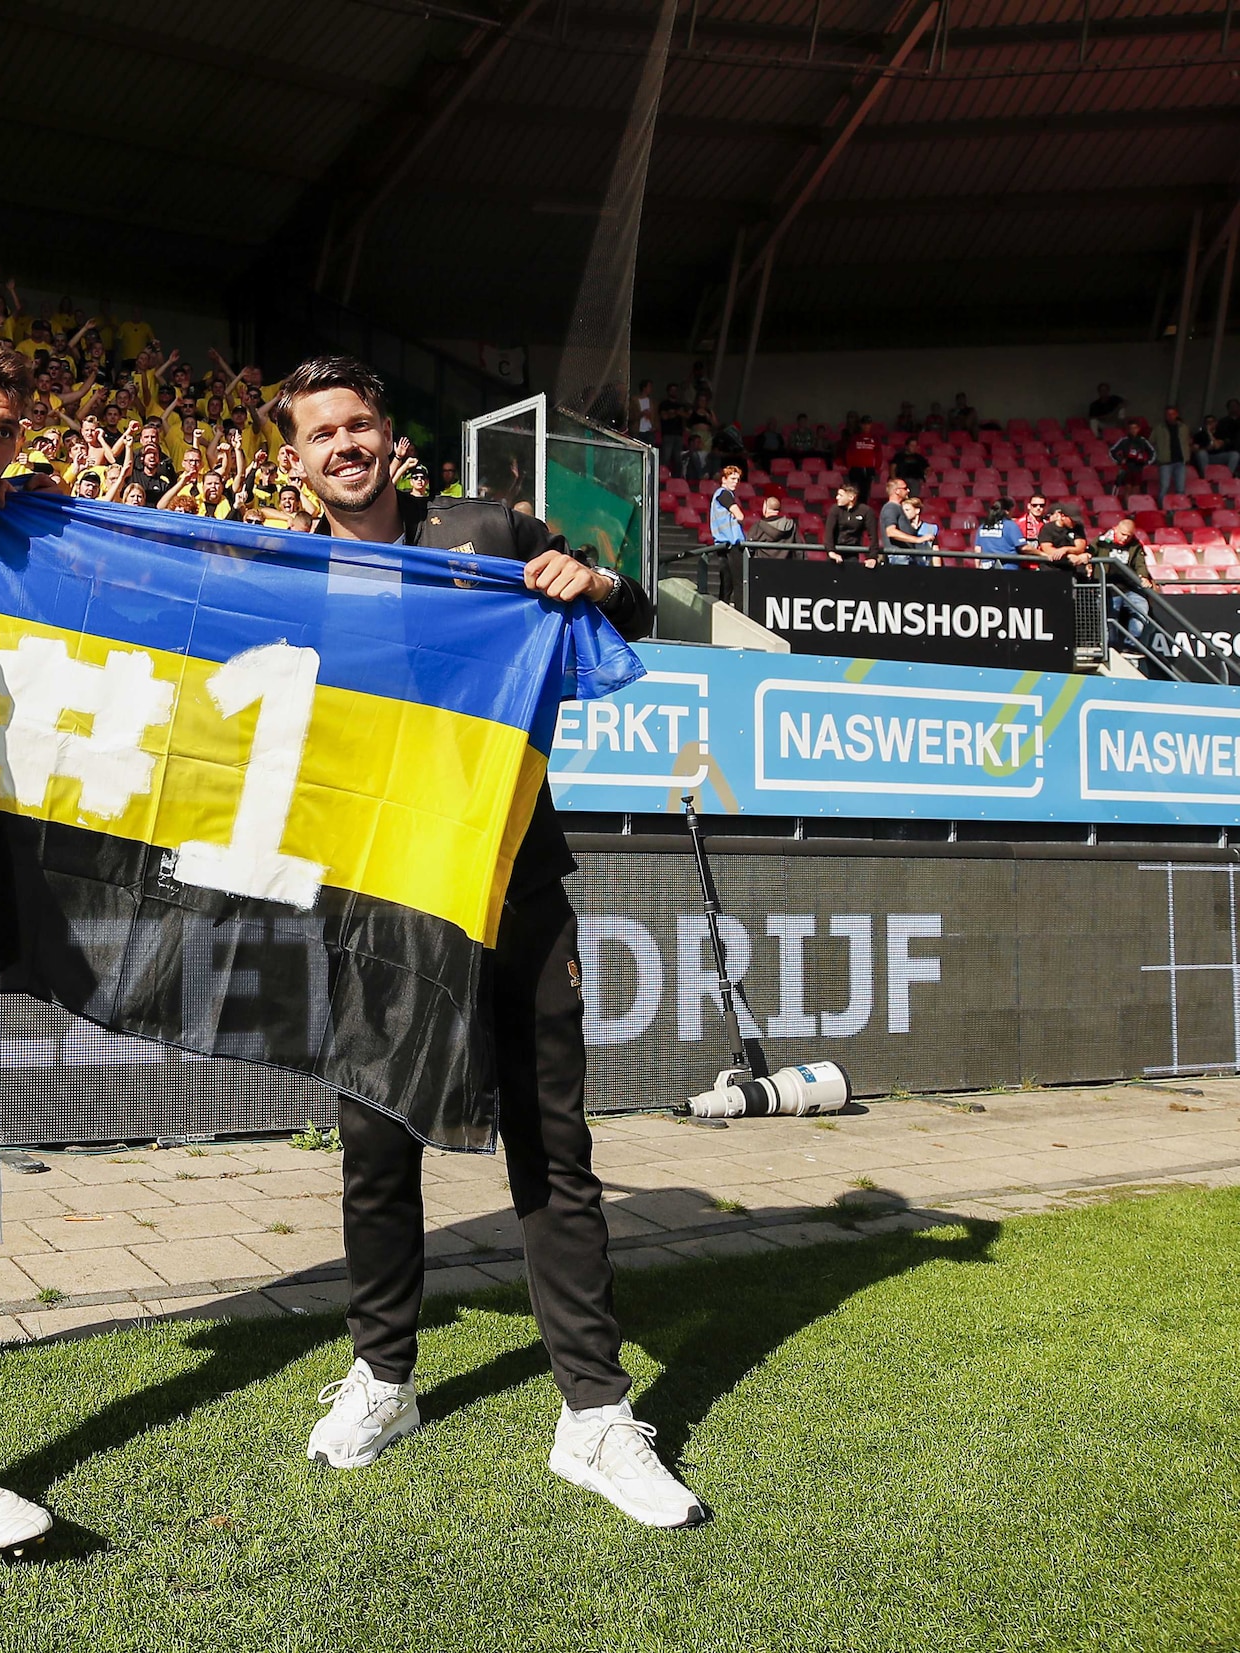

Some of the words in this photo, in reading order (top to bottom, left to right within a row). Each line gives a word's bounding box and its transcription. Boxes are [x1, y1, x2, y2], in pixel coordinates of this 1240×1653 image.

[765, 596, 1054, 641] NECFANSHOP.NL
[779, 711, 1044, 769] NASWERKT!
[1100, 729, 1240, 777] NASWE
